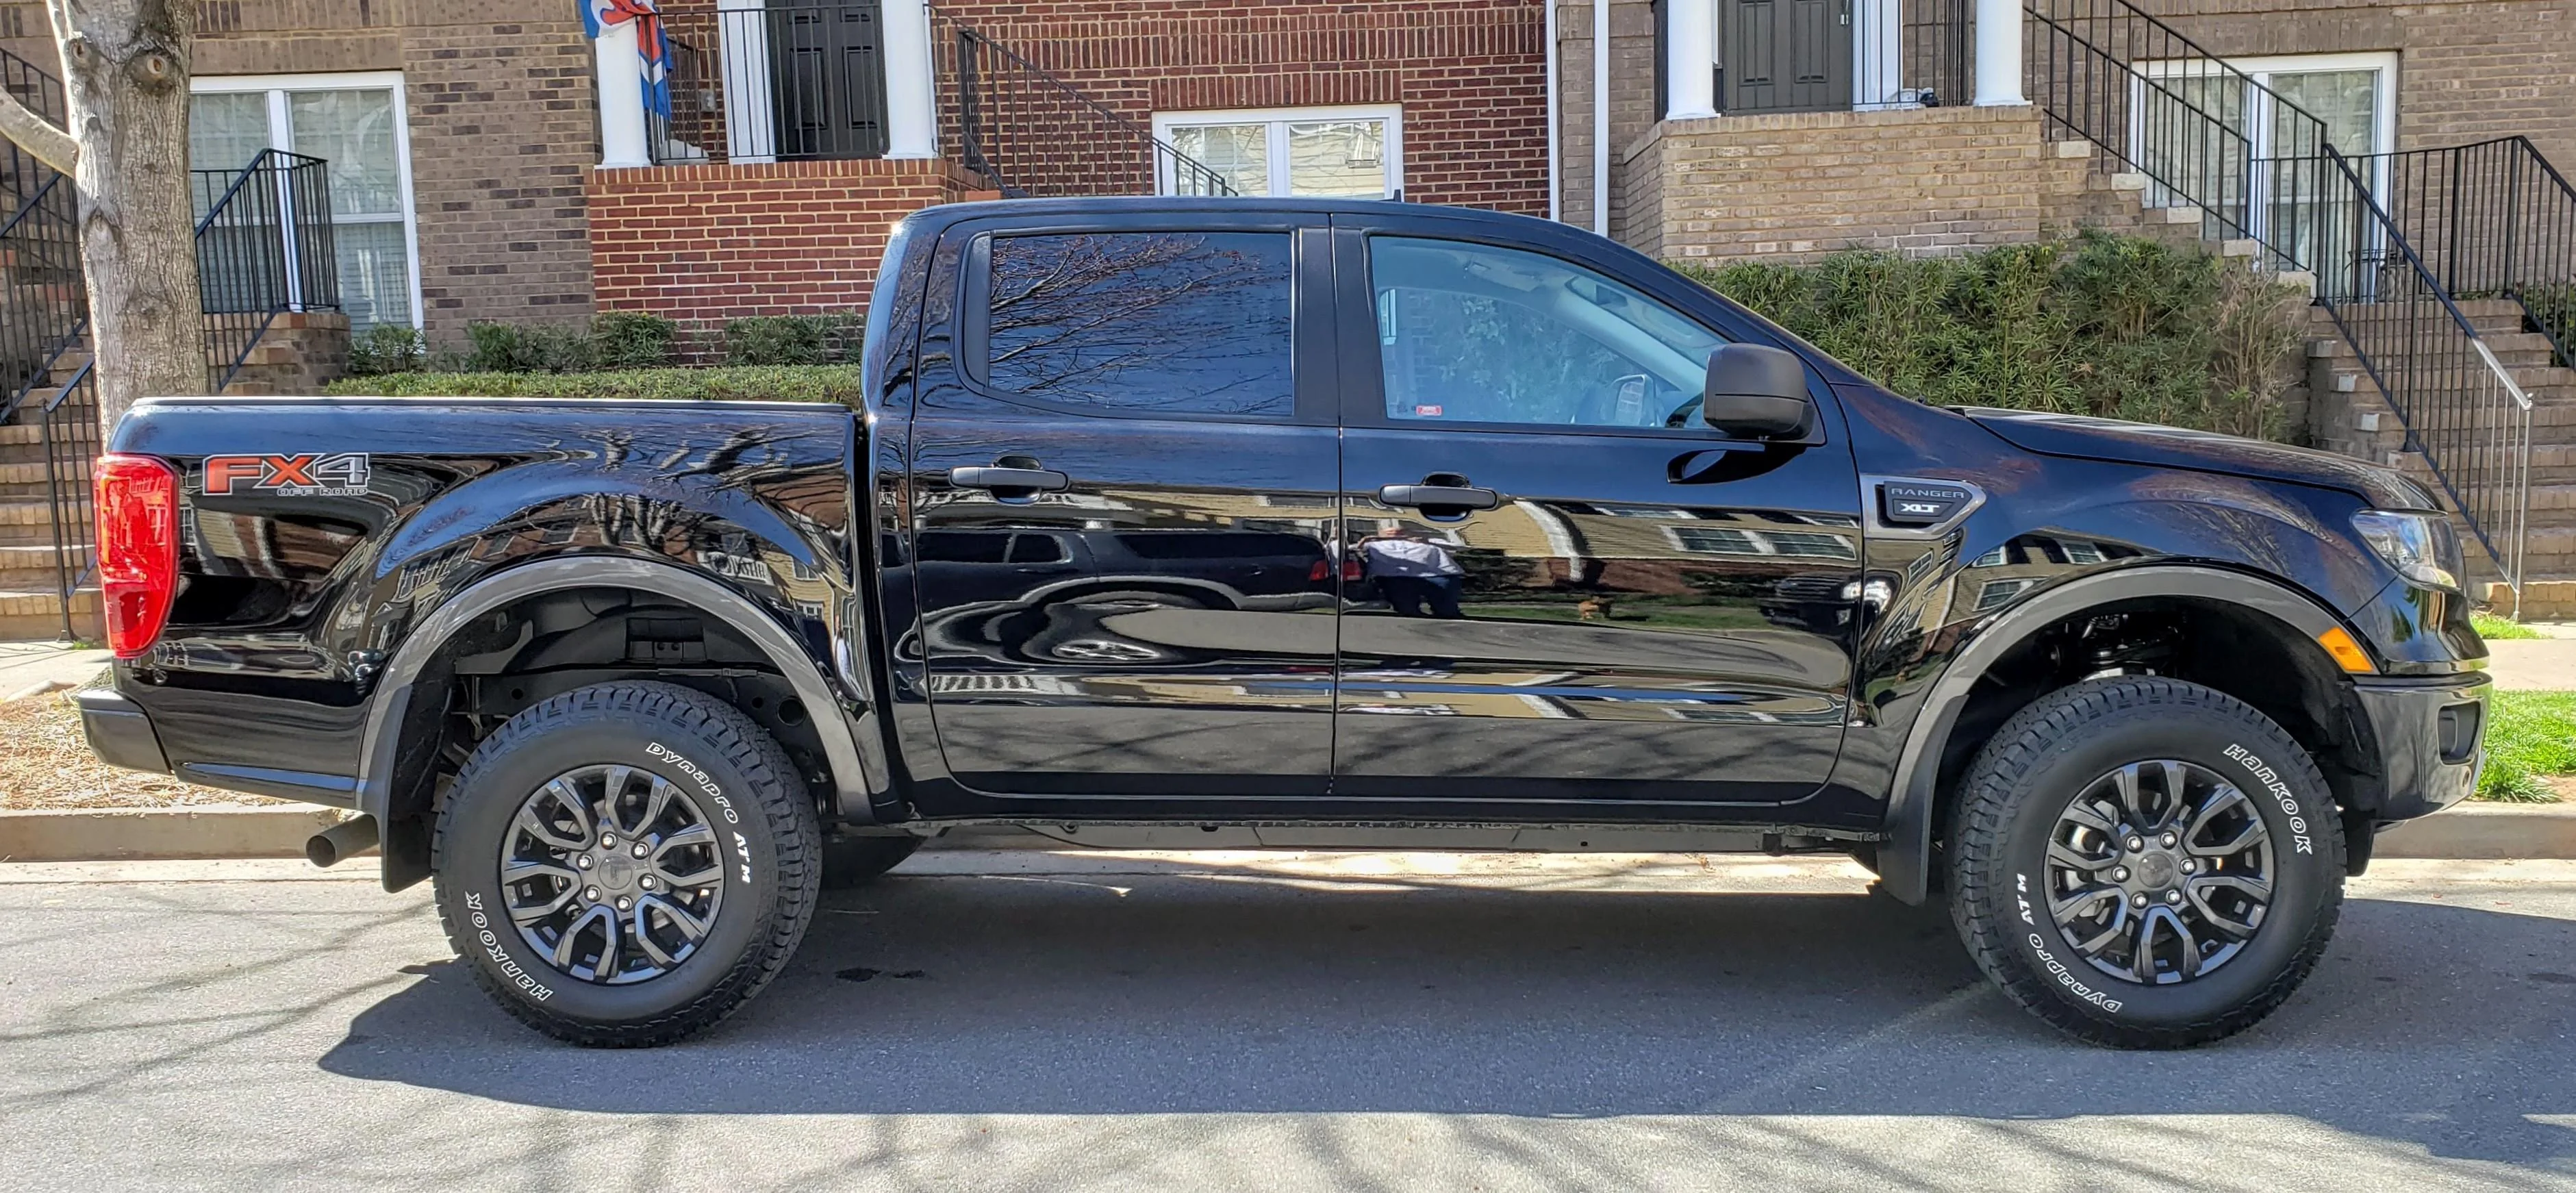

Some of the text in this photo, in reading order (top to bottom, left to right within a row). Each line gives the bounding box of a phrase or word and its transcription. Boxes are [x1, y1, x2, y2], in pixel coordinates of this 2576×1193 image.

[202, 452, 370, 496] FX4
[277, 487, 368, 497] OFF ROAD
[1891, 488, 1965, 499] RANGER
[1900, 503, 1940, 513] XLT
